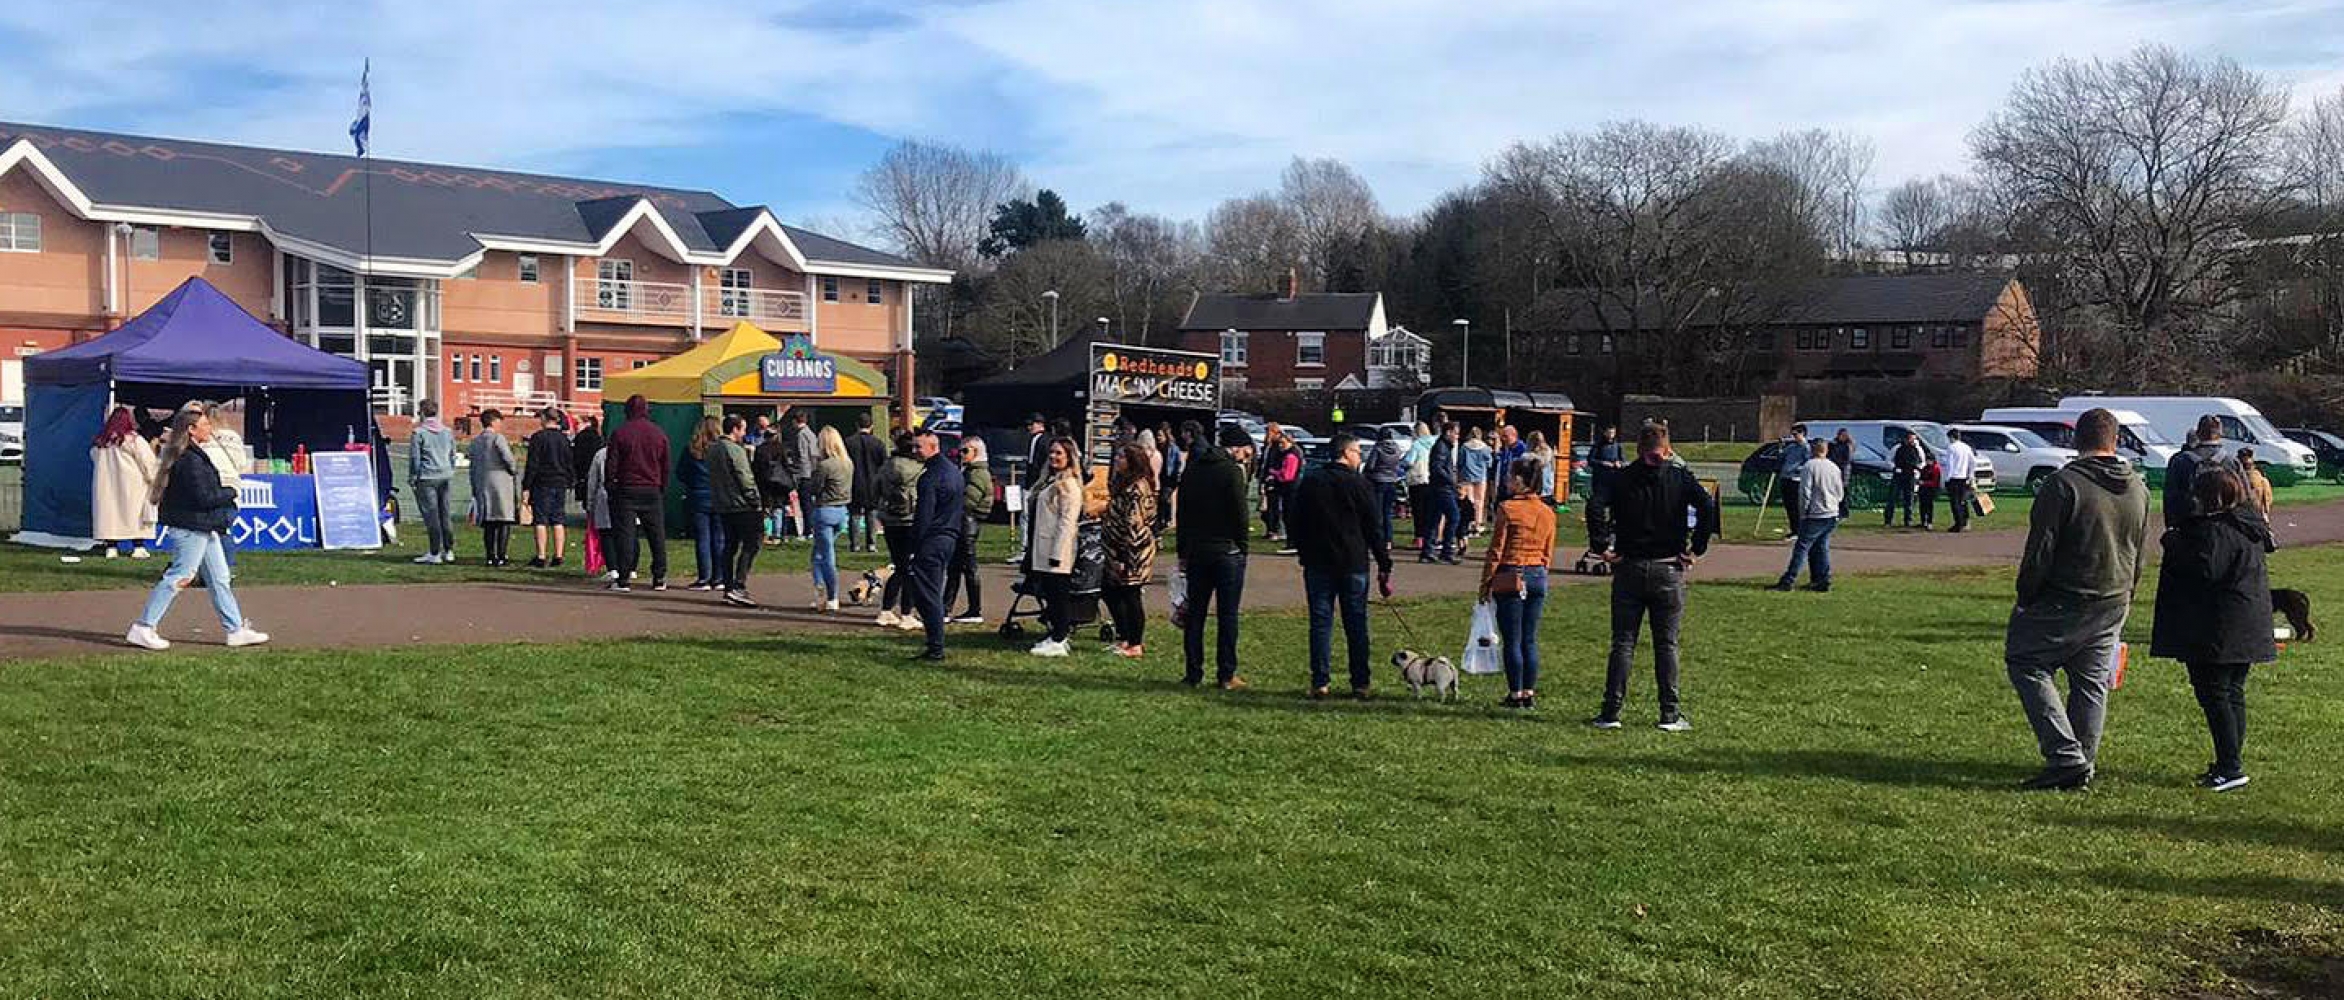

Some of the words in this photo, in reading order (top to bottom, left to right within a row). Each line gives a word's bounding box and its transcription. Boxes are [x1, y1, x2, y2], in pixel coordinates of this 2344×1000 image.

[767, 359, 832, 378] CUBANOS
[1120, 356, 1194, 378] Redheads
[1095, 374, 1132, 396] MAC
[1159, 380, 1214, 401] CHEESE
